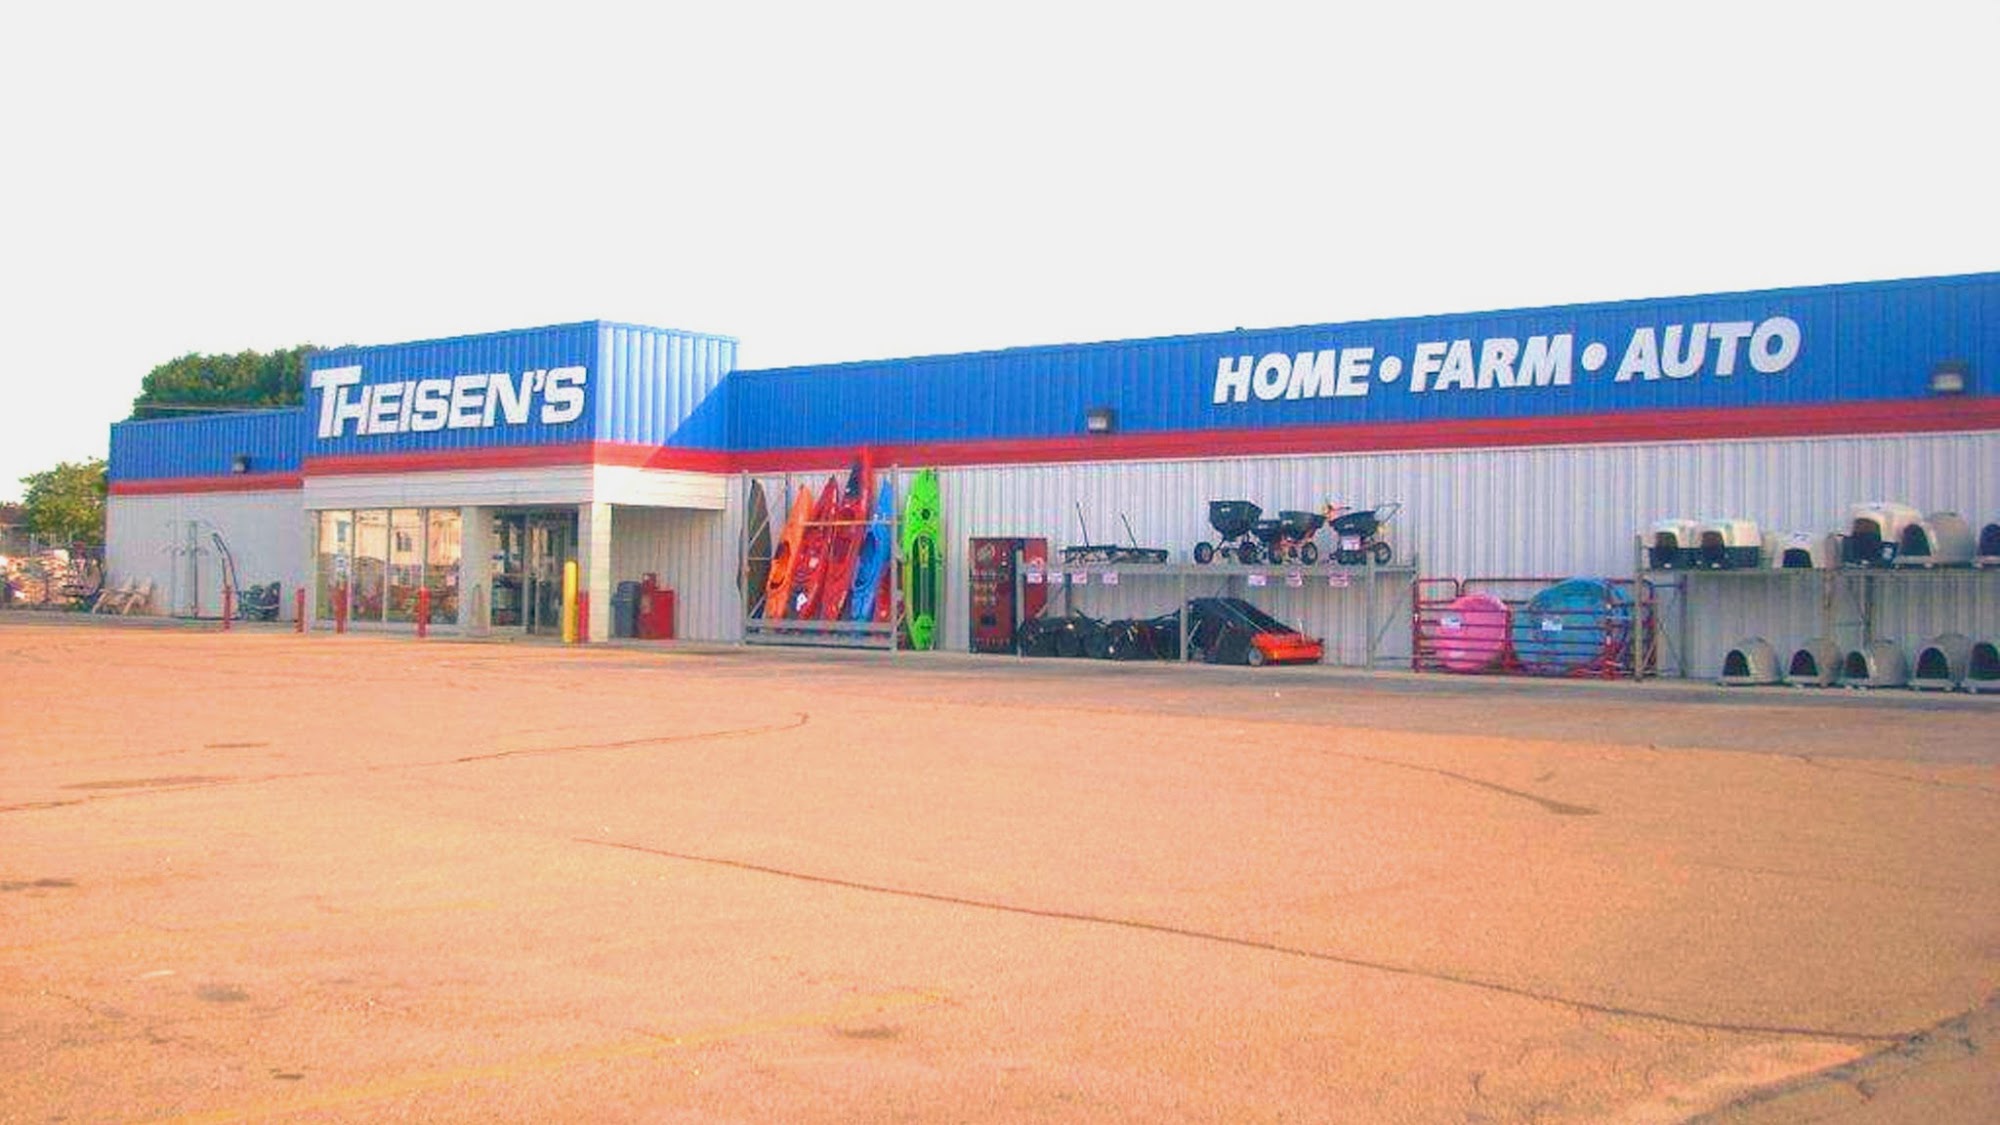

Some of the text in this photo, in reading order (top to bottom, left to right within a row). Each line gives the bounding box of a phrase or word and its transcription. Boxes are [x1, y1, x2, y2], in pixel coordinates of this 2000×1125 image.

[1213, 316, 1801, 404] HOME FARM AUTO
[310, 365, 587, 438] THEISEN'S
